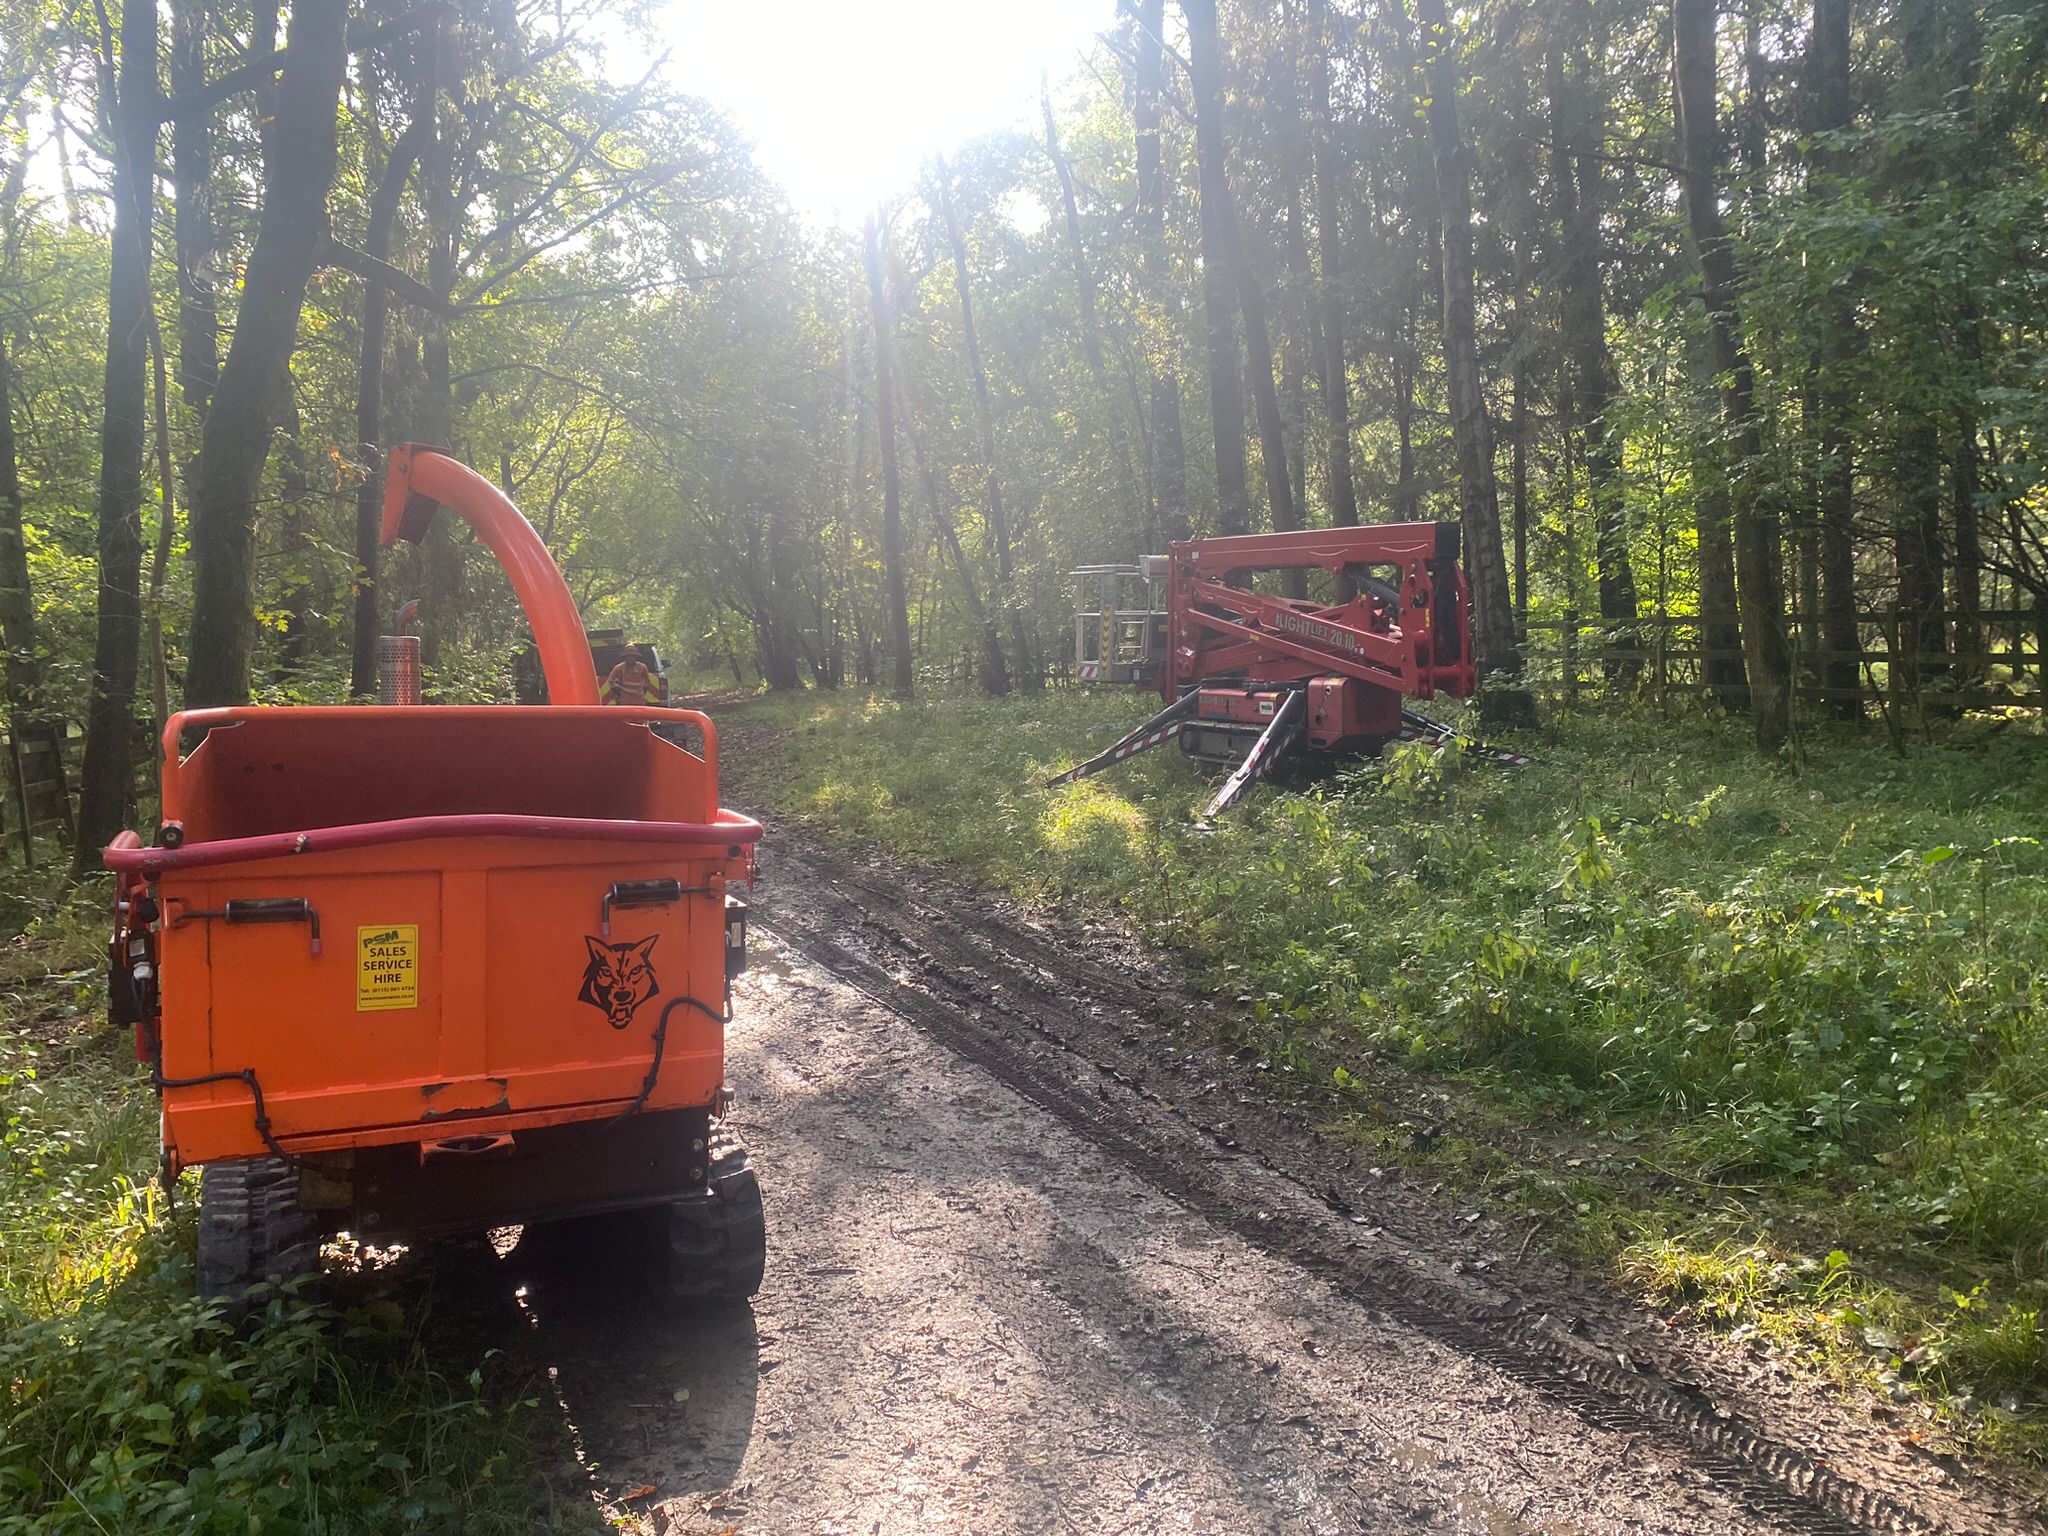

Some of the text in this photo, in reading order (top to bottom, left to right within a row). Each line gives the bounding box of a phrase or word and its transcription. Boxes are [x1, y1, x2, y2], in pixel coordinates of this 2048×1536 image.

[370, 947, 407, 957] SALES
[364, 960, 412, 971] SERVICE
[374, 974, 401, 984] HIRE
